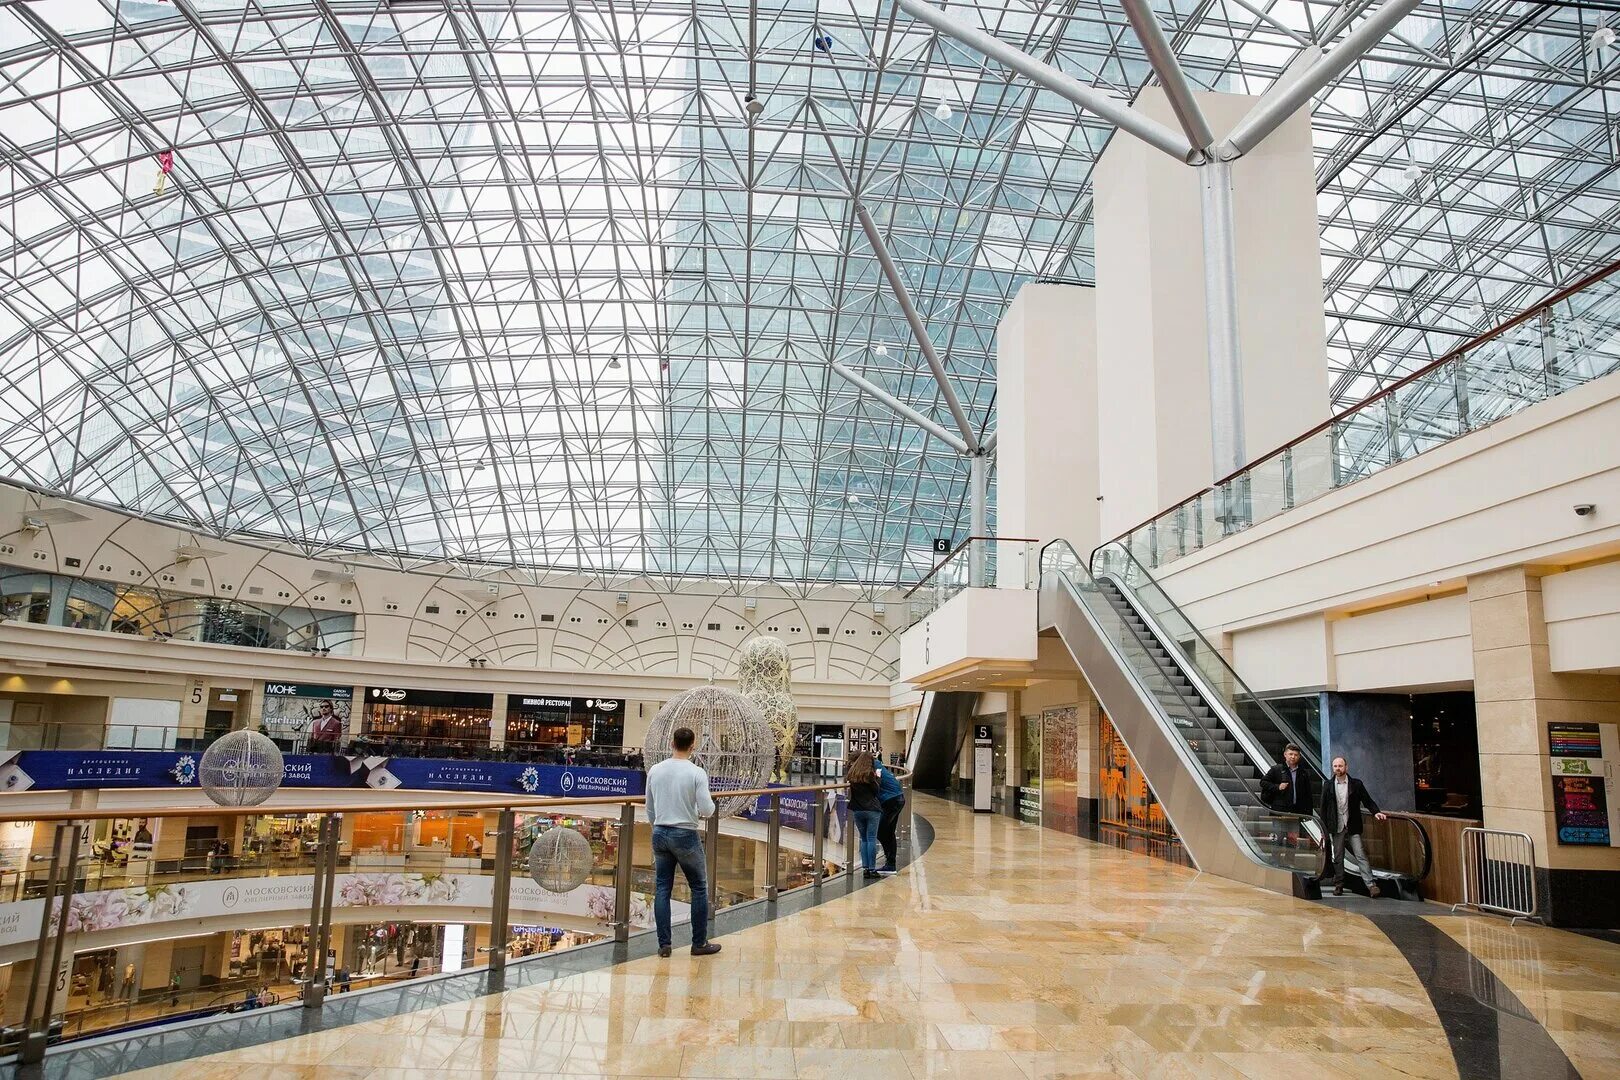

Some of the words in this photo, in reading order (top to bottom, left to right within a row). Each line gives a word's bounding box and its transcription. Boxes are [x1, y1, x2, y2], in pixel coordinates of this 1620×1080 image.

[938, 540, 945, 551] 6
[191, 687, 202, 704] 5
[523, 698, 545, 706] ПИВНОЙ
[545, 699, 571, 707] РЕСТОРАН
[850, 728, 878, 741] MAD
[980, 726, 987, 738] 5
[849, 741, 877, 753] MEN
[67, 767, 141, 775] НАСЛЕДИЕ
[428, 772, 493, 781] НАСЛЕДИЕ
[577, 776, 628, 786] МОСКОВСКИЙ
[577, 784, 610, 792] ЮВЕЛИРНЫЙ
[81, 825, 89, 844] 4
[245, 884, 313, 896] МОСКОВСКИЙ
[56, 970, 67, 991] 3
